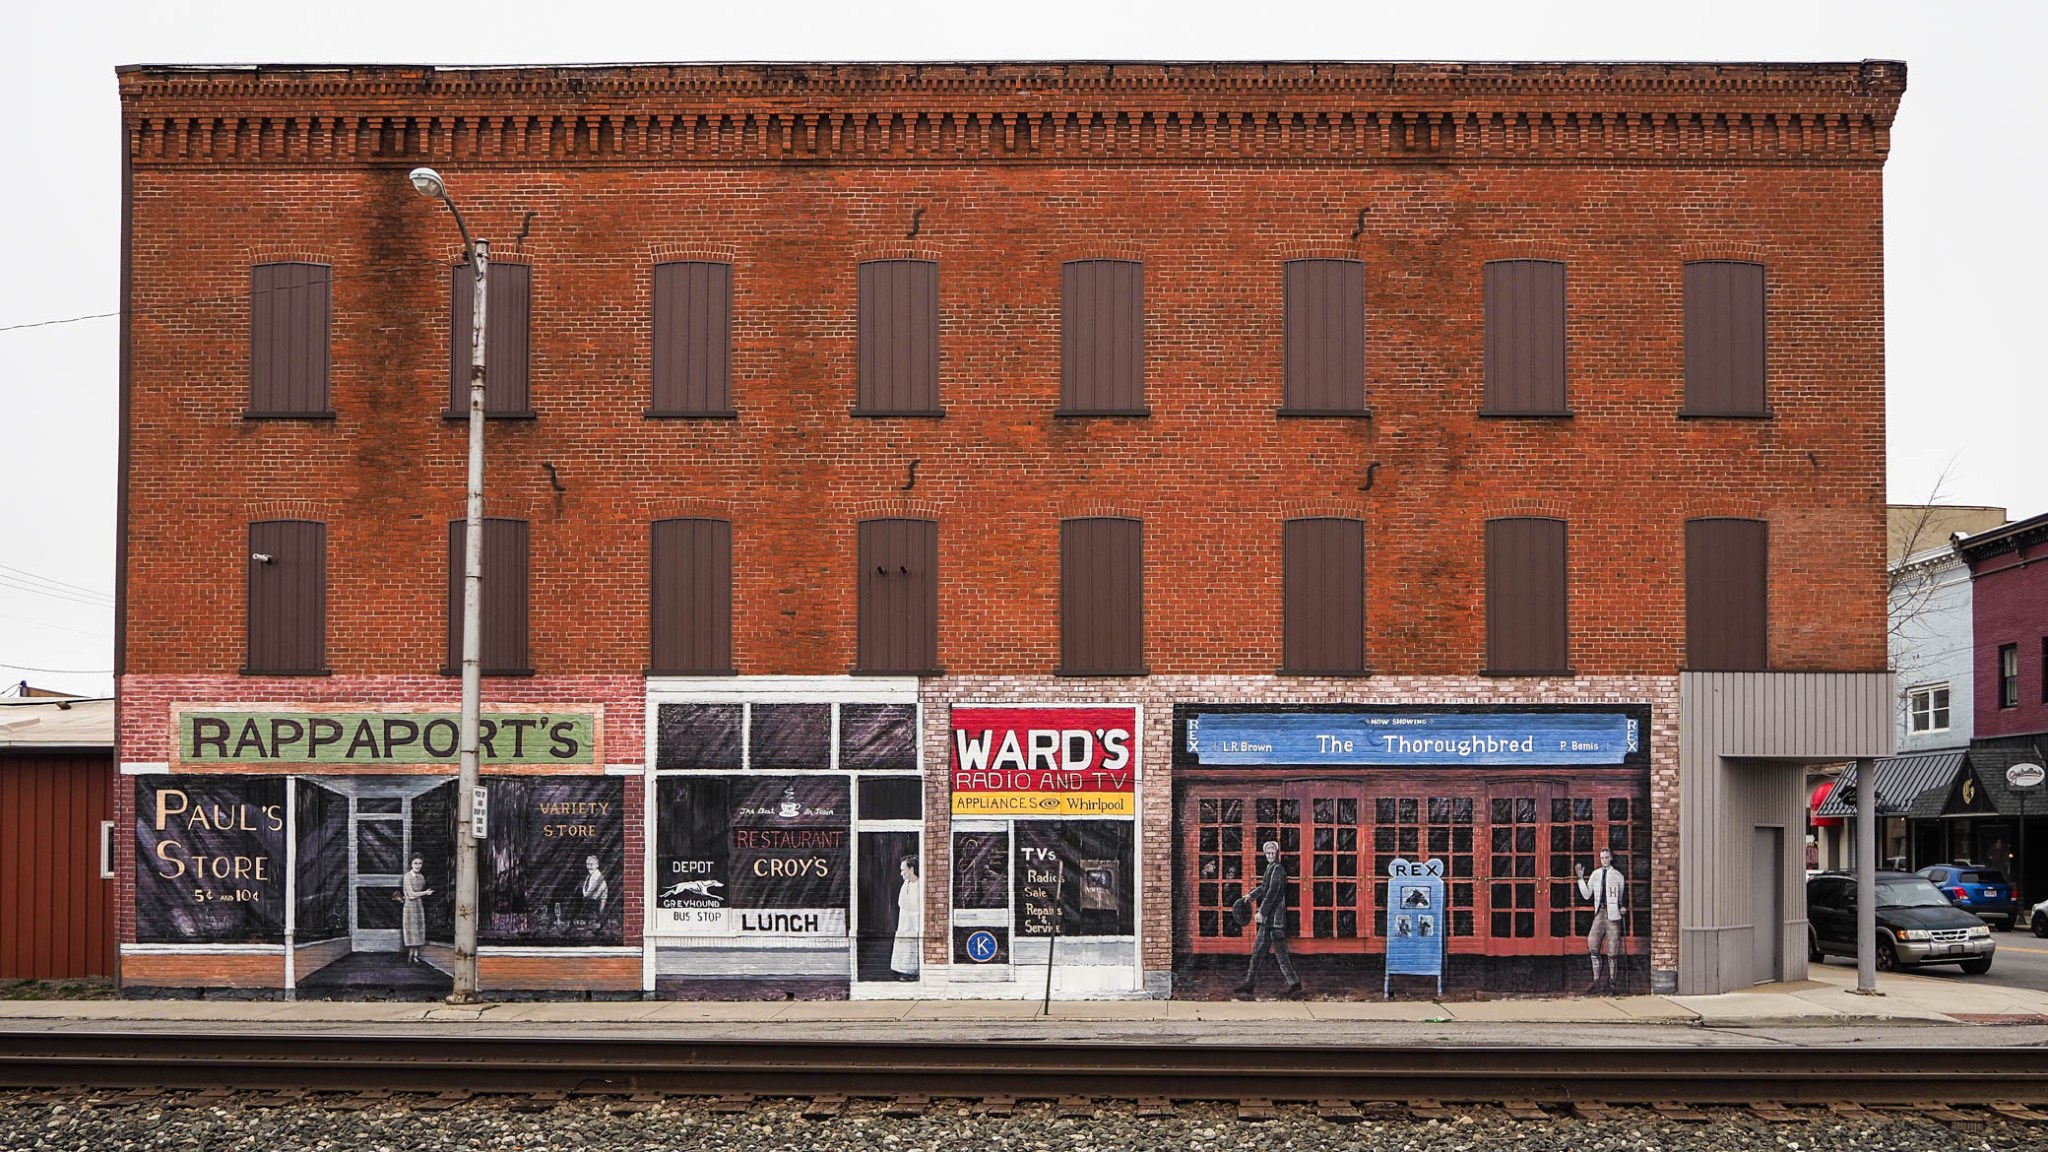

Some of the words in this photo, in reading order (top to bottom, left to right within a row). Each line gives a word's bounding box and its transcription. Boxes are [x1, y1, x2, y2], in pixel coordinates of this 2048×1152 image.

[1370, 718, 1389, 726] NOW
[1392, 718, 1427, 726] SHOWING
[1189, 720, 1199, 752] REX
[1627, 720, 1638, 752] REX
[956, 728, 1131, 771] WARD'S
[1241, 741, 1272, 752] Brown
[1316, 735, 1354, 753] The
[1382, 735, 1533, 756] Thoroughbred
[1039, 773, 1083, 790] AND
[1092, 773, 1128, 790] TV
[540, 802, 609, 816] VARIETY
[740, 807, 755, 815] The
[757, 806, 776, 815] Best
[815, 808, 834, 816] Town
[957, 797, 1038, 810] APPLIANCES
[1067, 797, 1124, 813] Whirlpool
[544, 824, 597, 837] STORE
[737, 830, 844, 849] RESTAURANT
[1021, 847, 1056, 861] TVs
[672, 861, 714, 873] DEPOT
[754, 856, 829, 878] CROY'S
[1395, 865, 1438, 876] REX
[1024, 887, 1047, 898] Sale
[1609, 886, 1617, 897] H
[663, 899, 720, 908] GREYHOUND
[673, 911, 690, 922] BUS
[697, 911, 722, 922] STOP
[1041, 915, 1048, 925] &
[977, 936, 990, 955] K
